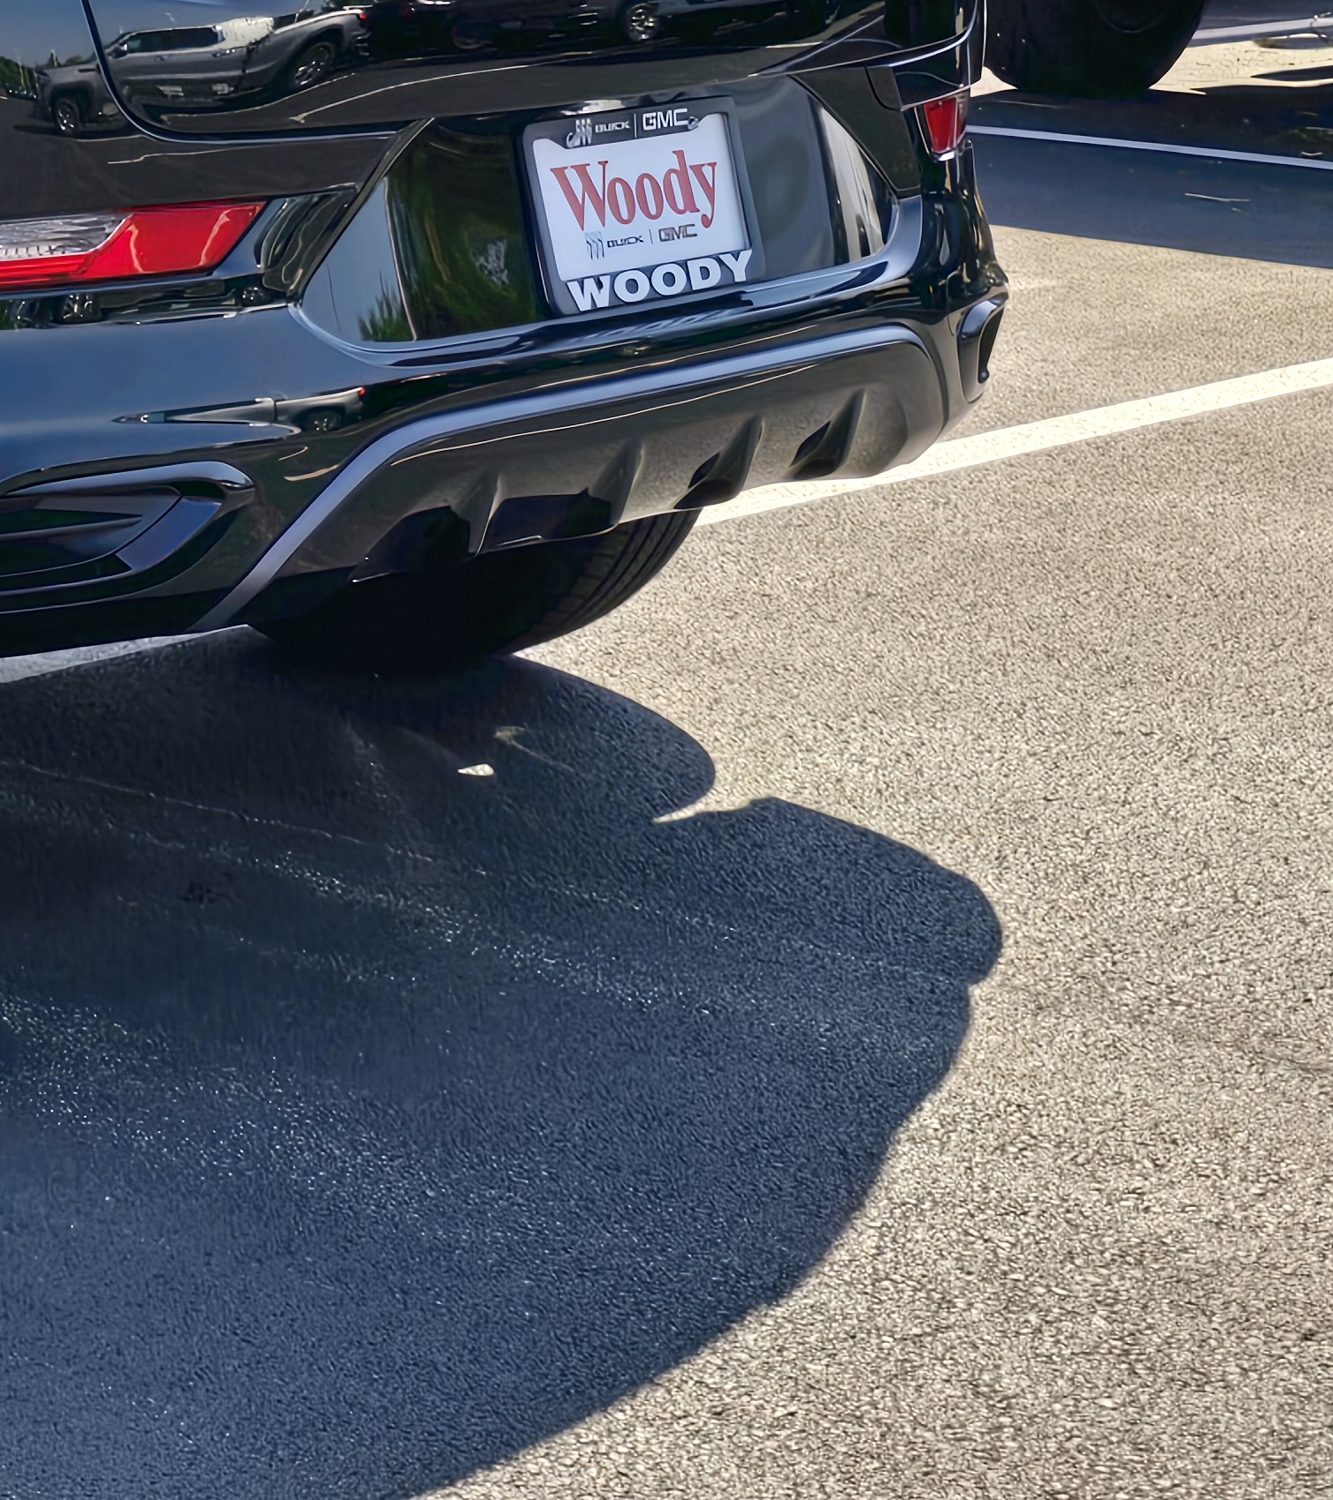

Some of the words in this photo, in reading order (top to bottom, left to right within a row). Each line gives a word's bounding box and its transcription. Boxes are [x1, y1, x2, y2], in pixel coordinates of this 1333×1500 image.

[595, 120, 631, 133] BUICK
[642, 108, 688, 131] GMC
[550, 150, 717, 231] Woody
[607, 235, 644, 248] BUICK
[658, 224, 697, 242] GMC
[566, 249, 752, 312] WOODY
